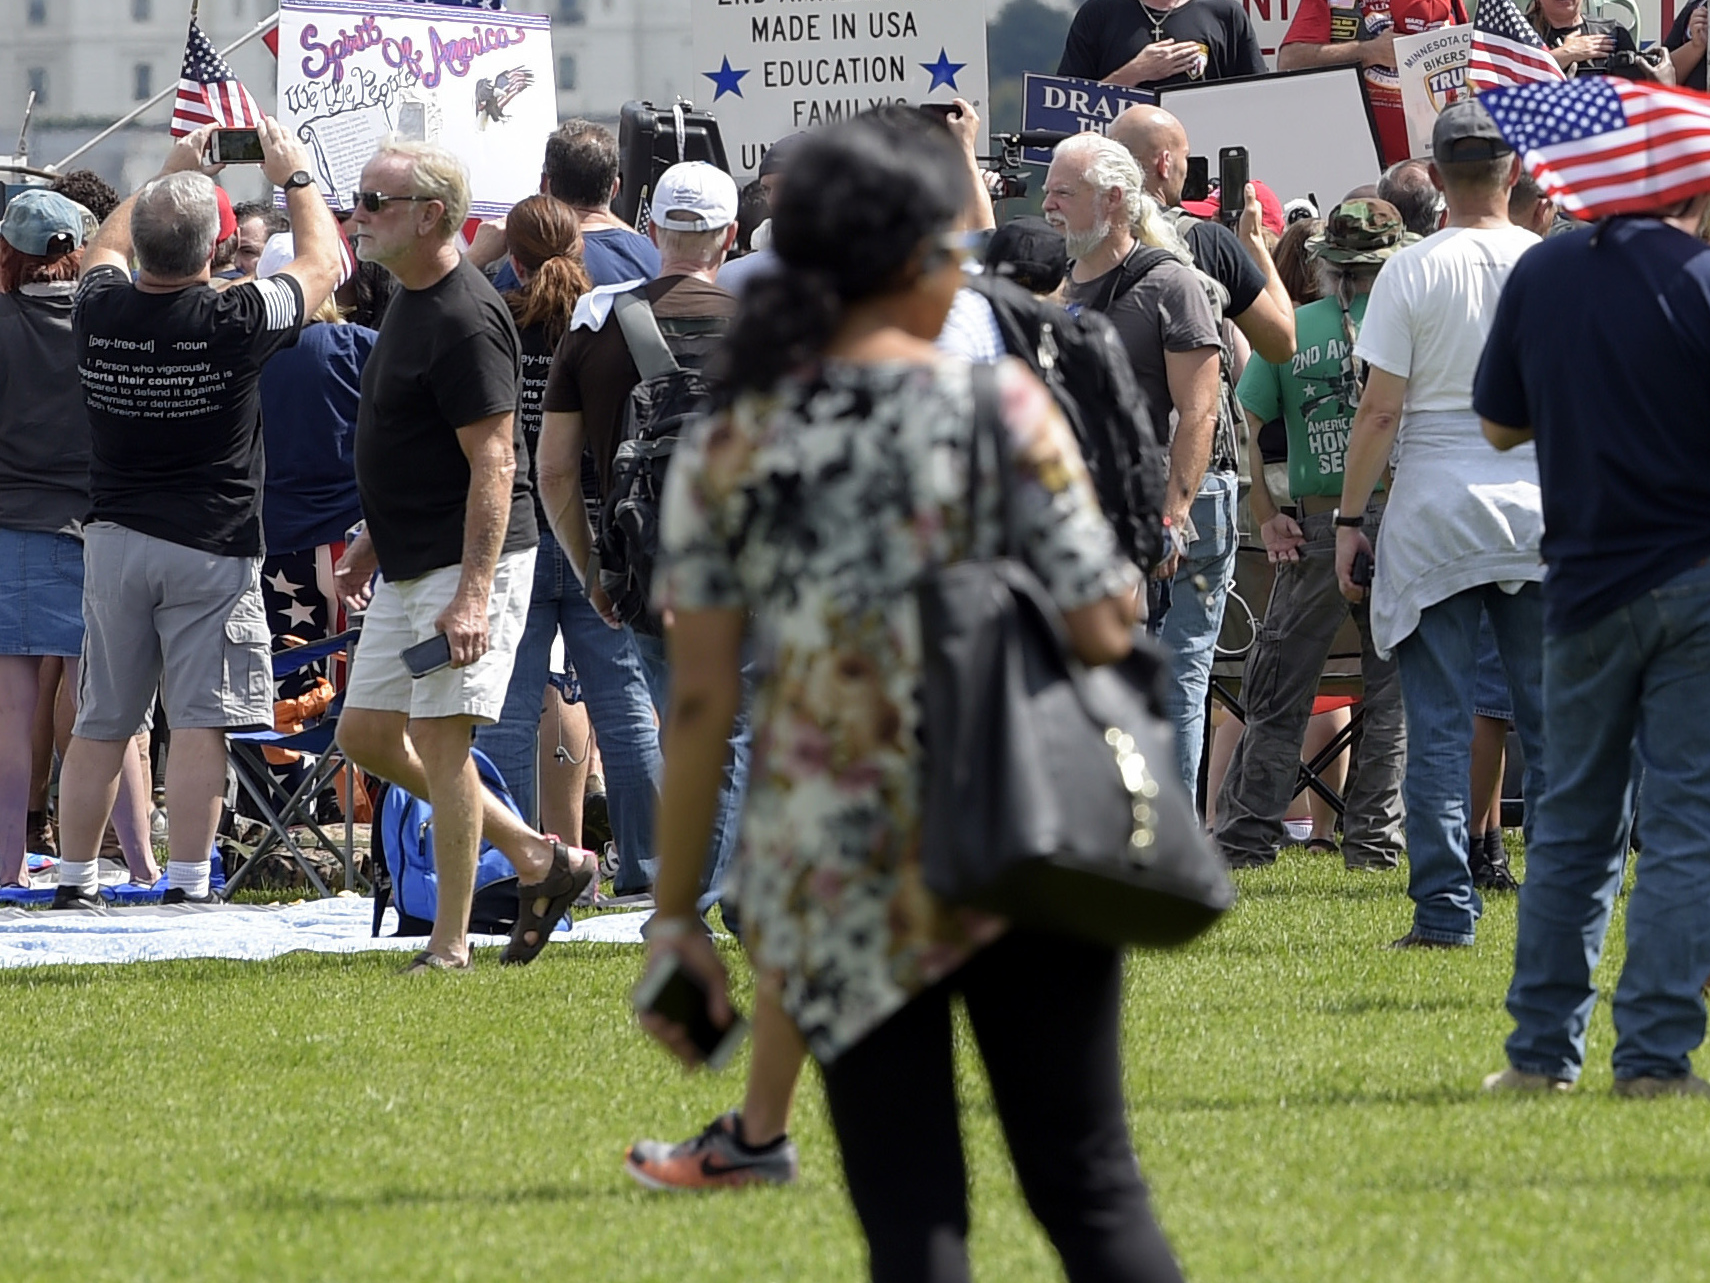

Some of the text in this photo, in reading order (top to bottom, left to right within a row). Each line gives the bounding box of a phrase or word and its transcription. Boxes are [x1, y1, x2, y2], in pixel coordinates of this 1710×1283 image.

[752, 11, 917, 43] MADE IN USA
[422, 26, 525, 89] America
[1404, 36, 1460, 69] MINNESOTA
[1423, 50, 1466, 72] BIKERS
[764, 55, 905, 88] EDUCATION
[1429, 67, 1469, 91] TRU
[1043, 86, 1141, 119] DRAI
[172, 341, 208, 351] -noun
[95, 359, 129, 372] Person
[132, 364, 154, 373] who
[157, 362, 211, 375] vigorously
[1292, 346, 1320, 375] 2ND
[118, 375, 145, 385] their
[148, 376, 195, 386] country
[199, 372, 220, 382] and
[223, 370, 233, 378] is
[121, 387, 131, 395] to
[134, 388, 171, 397] defend
[184, 382, 226, 397] against
